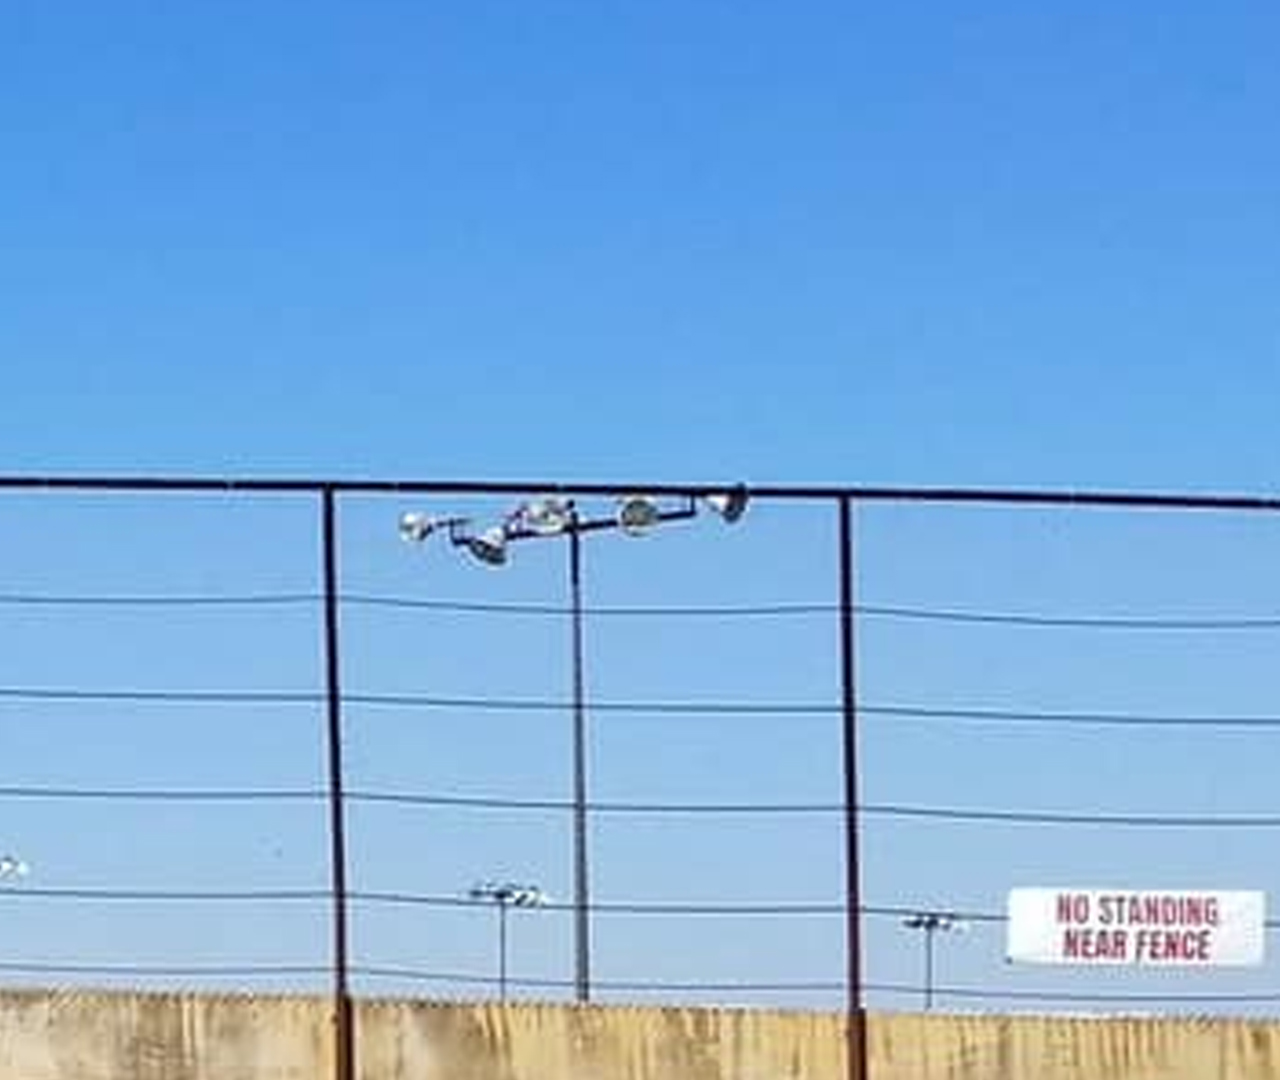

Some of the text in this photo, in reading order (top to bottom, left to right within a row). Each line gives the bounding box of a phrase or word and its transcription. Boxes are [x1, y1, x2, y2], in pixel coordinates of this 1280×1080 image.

[1056, 893, 1218, 926] NO STANDING
[1063, 930, 1212, 961] NEAR FENCE
